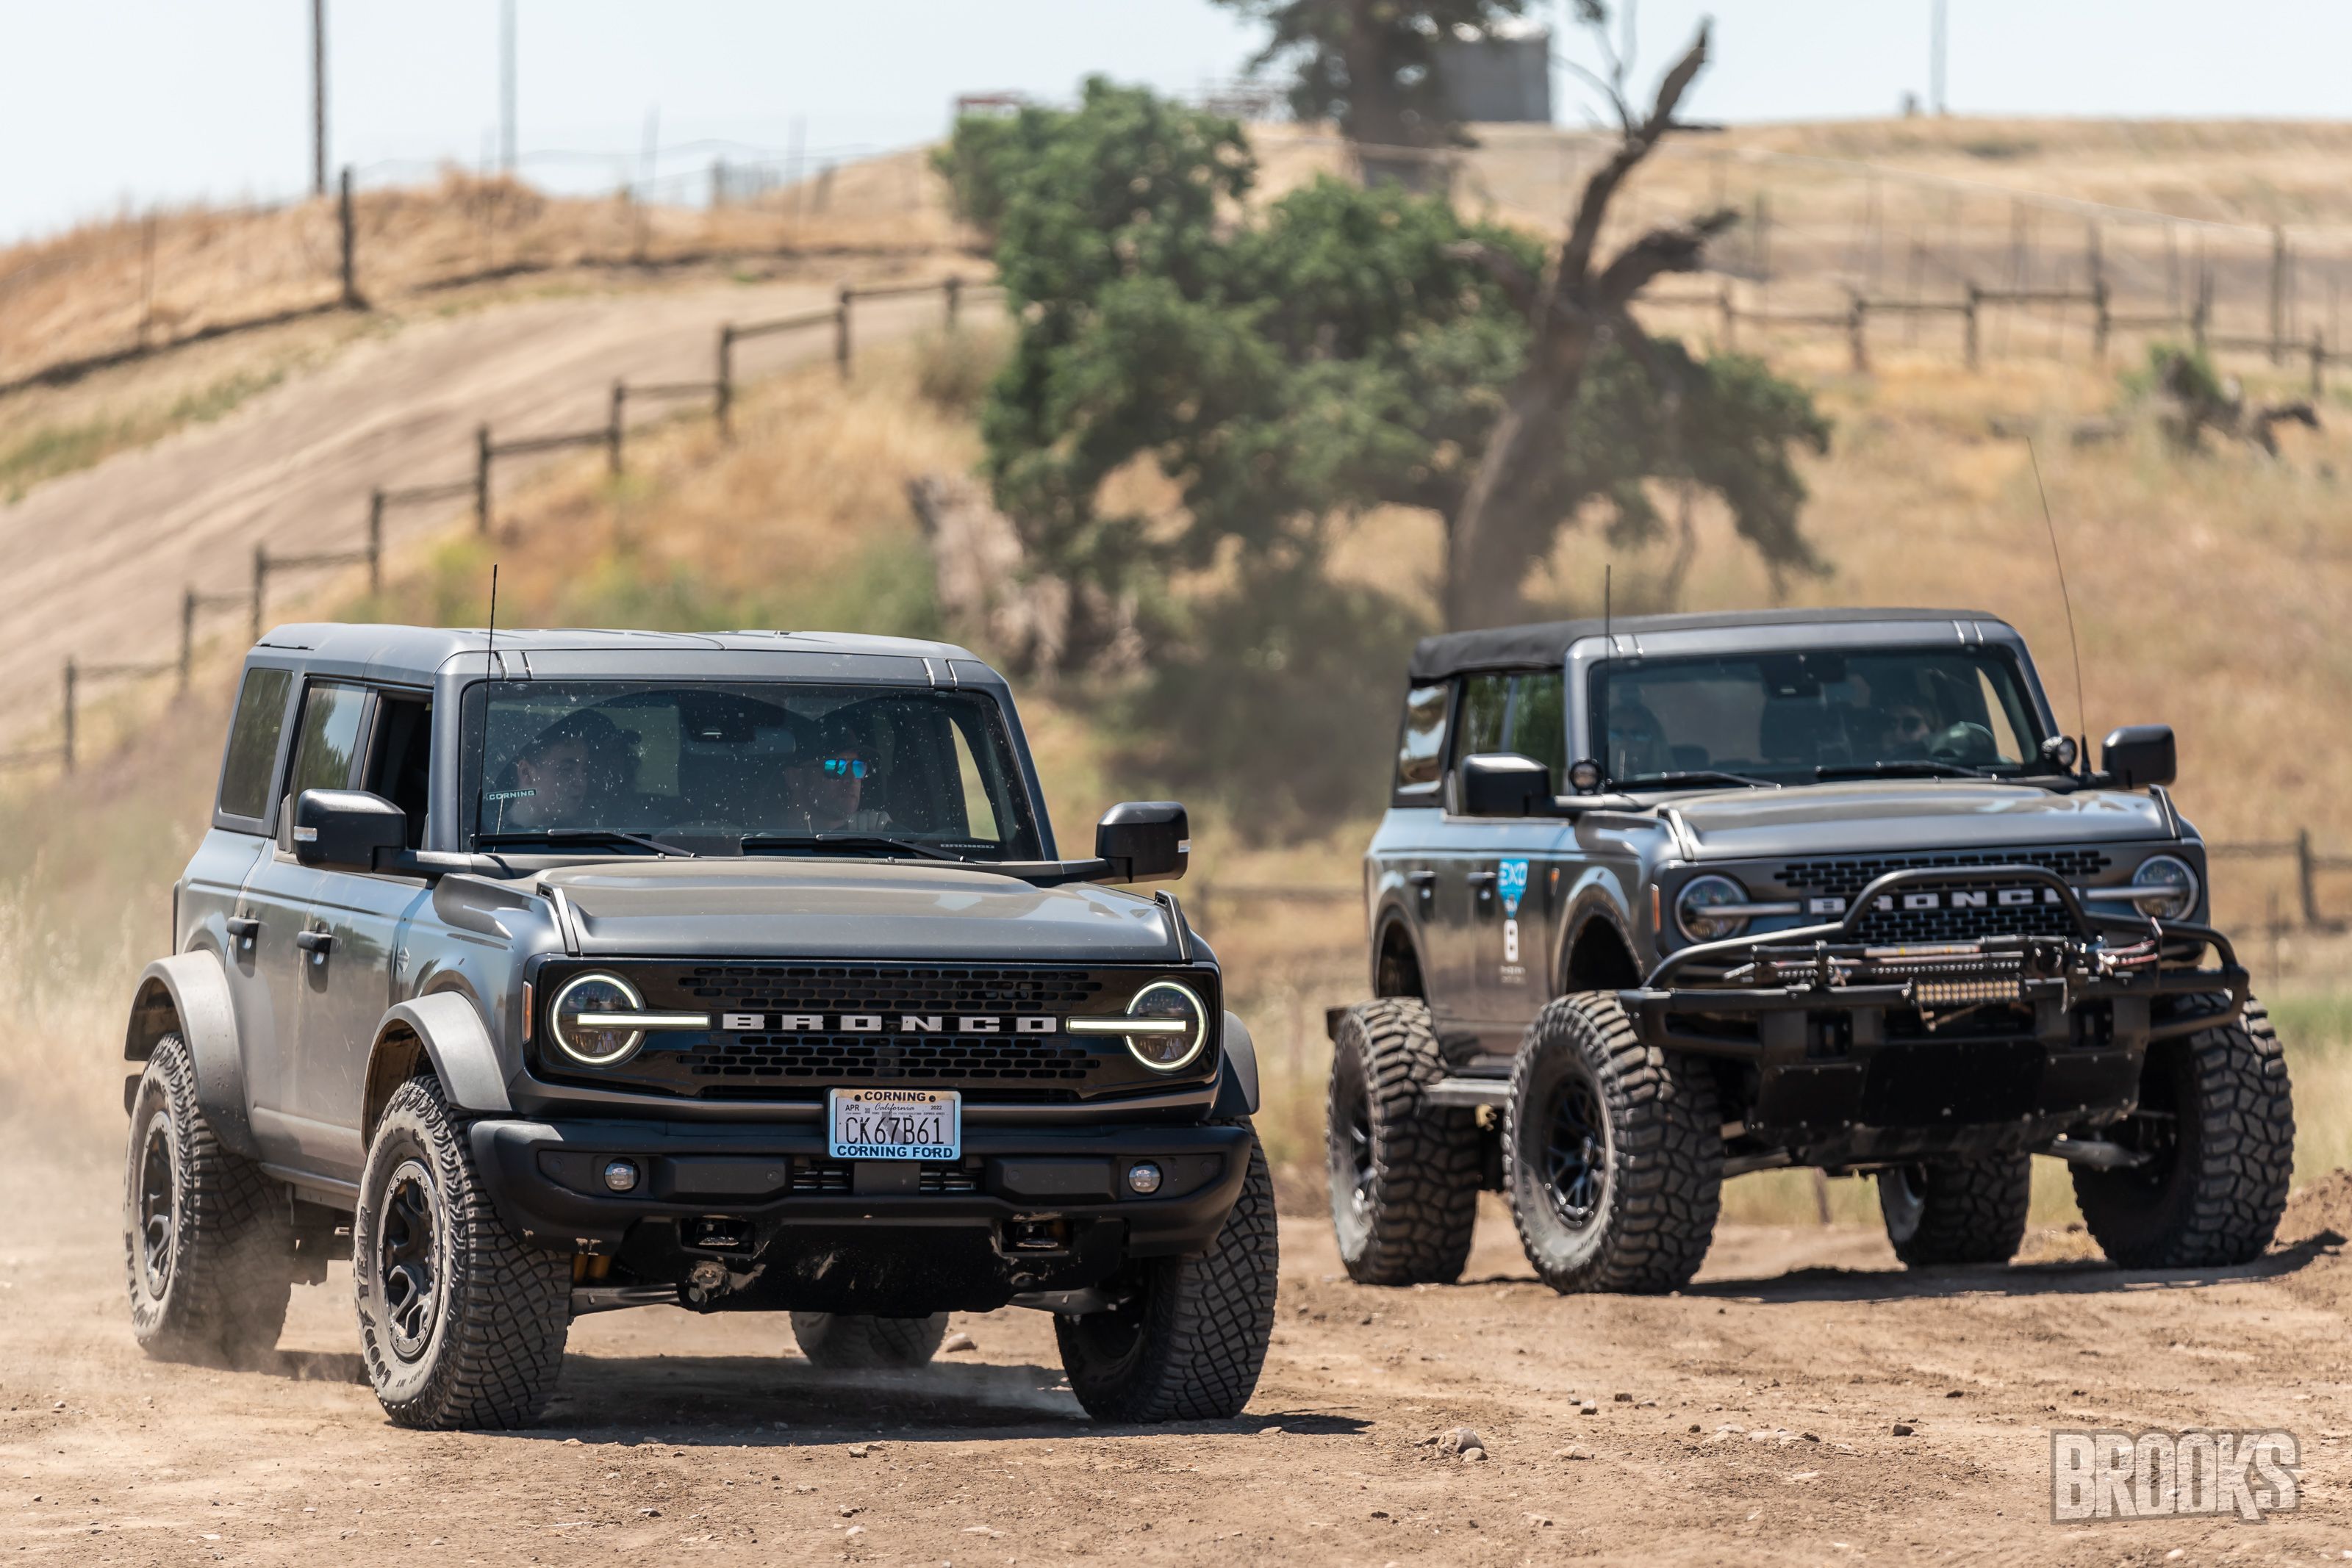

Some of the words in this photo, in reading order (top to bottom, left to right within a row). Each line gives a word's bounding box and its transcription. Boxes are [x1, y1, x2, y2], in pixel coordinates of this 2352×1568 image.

[489, 790, 534, 800] CORNING
[723, 1013, 1057, 1032] BRONCO
[864, 1091, 926, 1101] CORNING
[875, 1102, 914, 1115] California
[845, 1117, 944, 1145] CK67B61
[837, 1146, 906, 1157] CORNING
[913, 1147, 953, 1158] FORD
